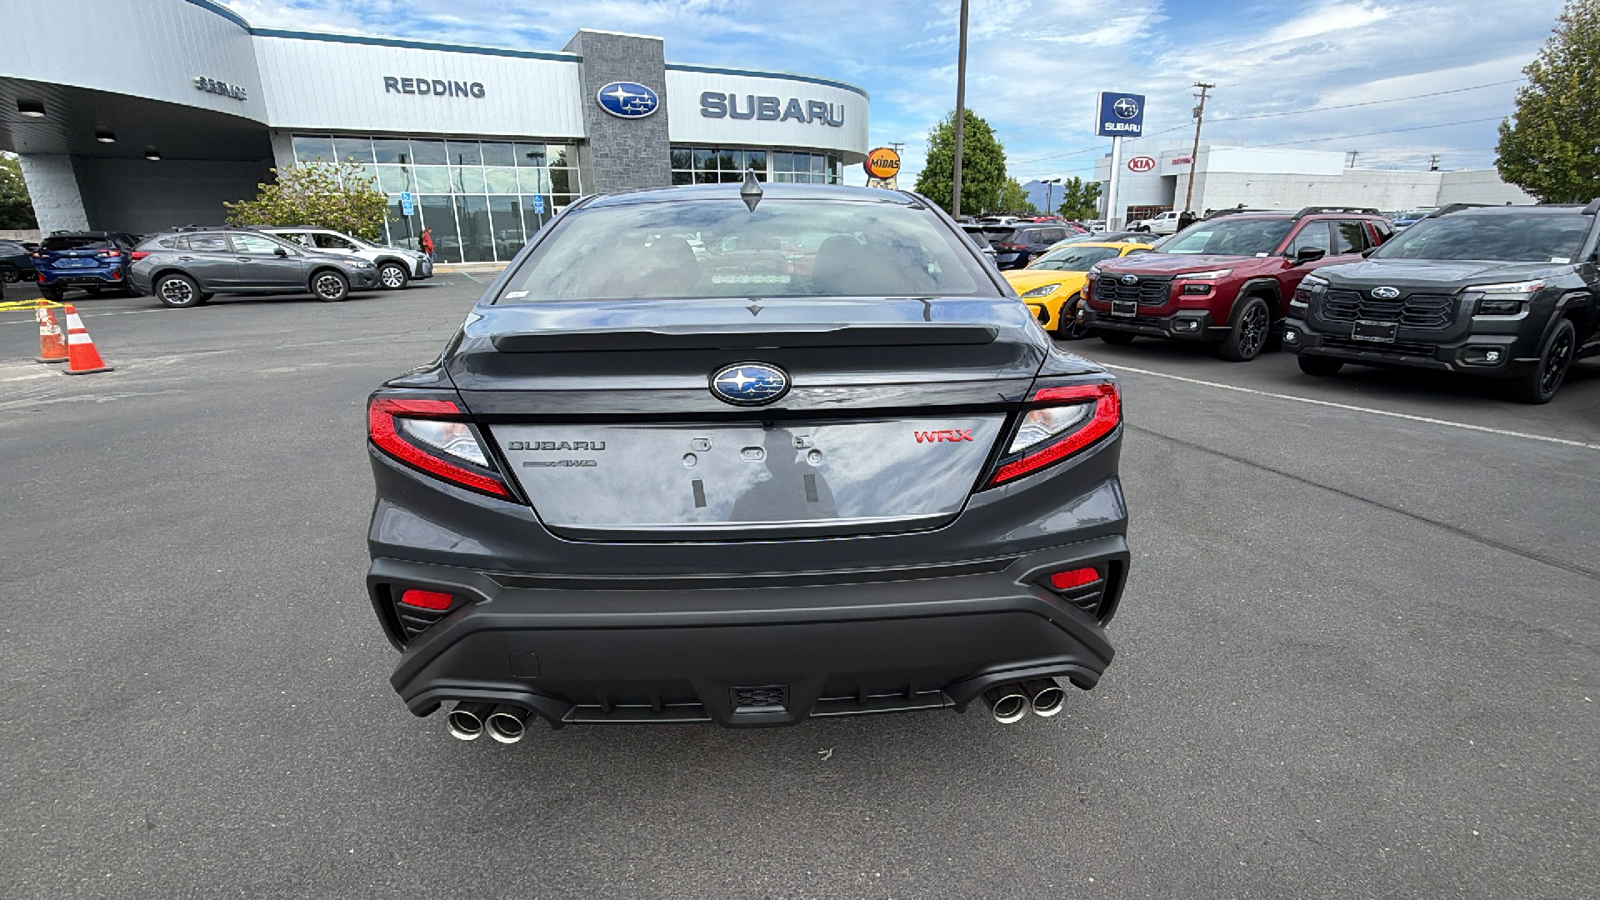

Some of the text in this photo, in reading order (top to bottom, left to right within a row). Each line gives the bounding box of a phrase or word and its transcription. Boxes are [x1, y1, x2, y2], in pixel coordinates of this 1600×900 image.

[383, 76, 486, 98] REDDING
[700, 91, 845, 127] SUBARU
[1104, 122, 1141, 132] SUBARU
[871, 155, 900, 169] MIDAS
[1132, 159, 1151, 169] KIA
[914, 429, 974, 443] WRX
[508, 441, 606, 451] SUBARU
